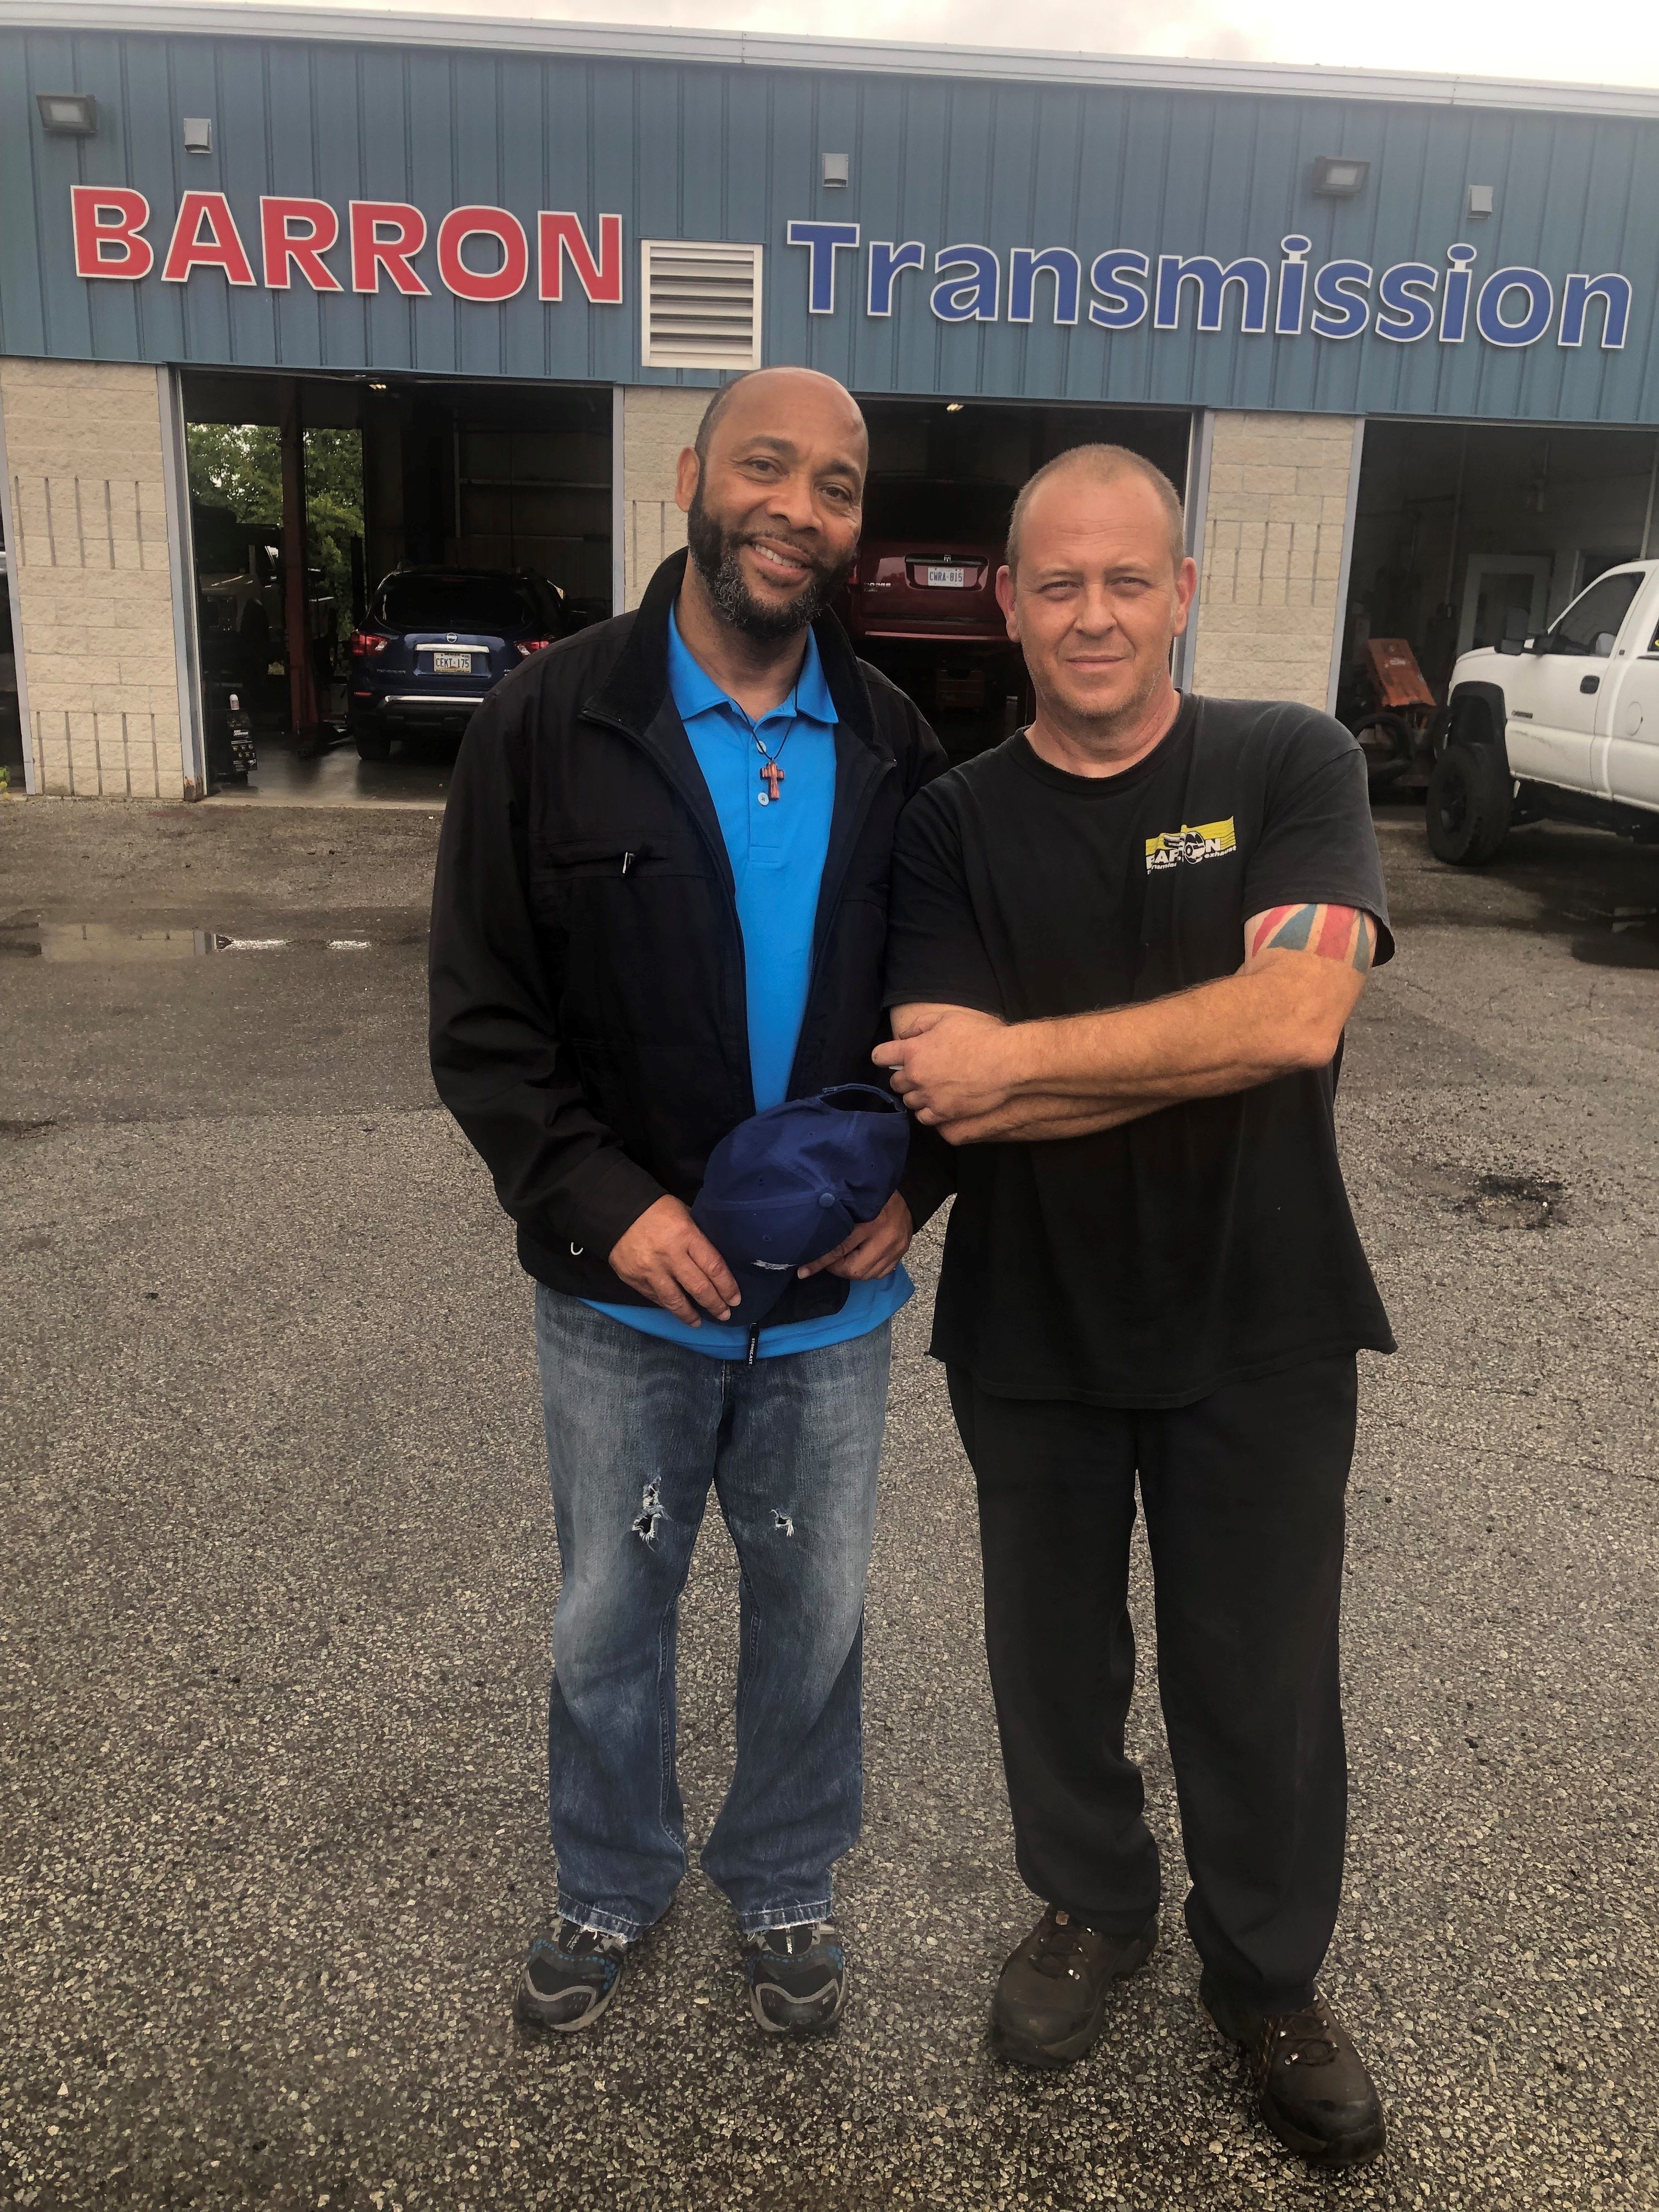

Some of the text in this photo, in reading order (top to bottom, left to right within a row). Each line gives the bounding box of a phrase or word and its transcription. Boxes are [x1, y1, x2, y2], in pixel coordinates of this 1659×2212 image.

[70, 185, 1633, 349] BARRON Transmission
[436, 658, 453, 668] CEKT
